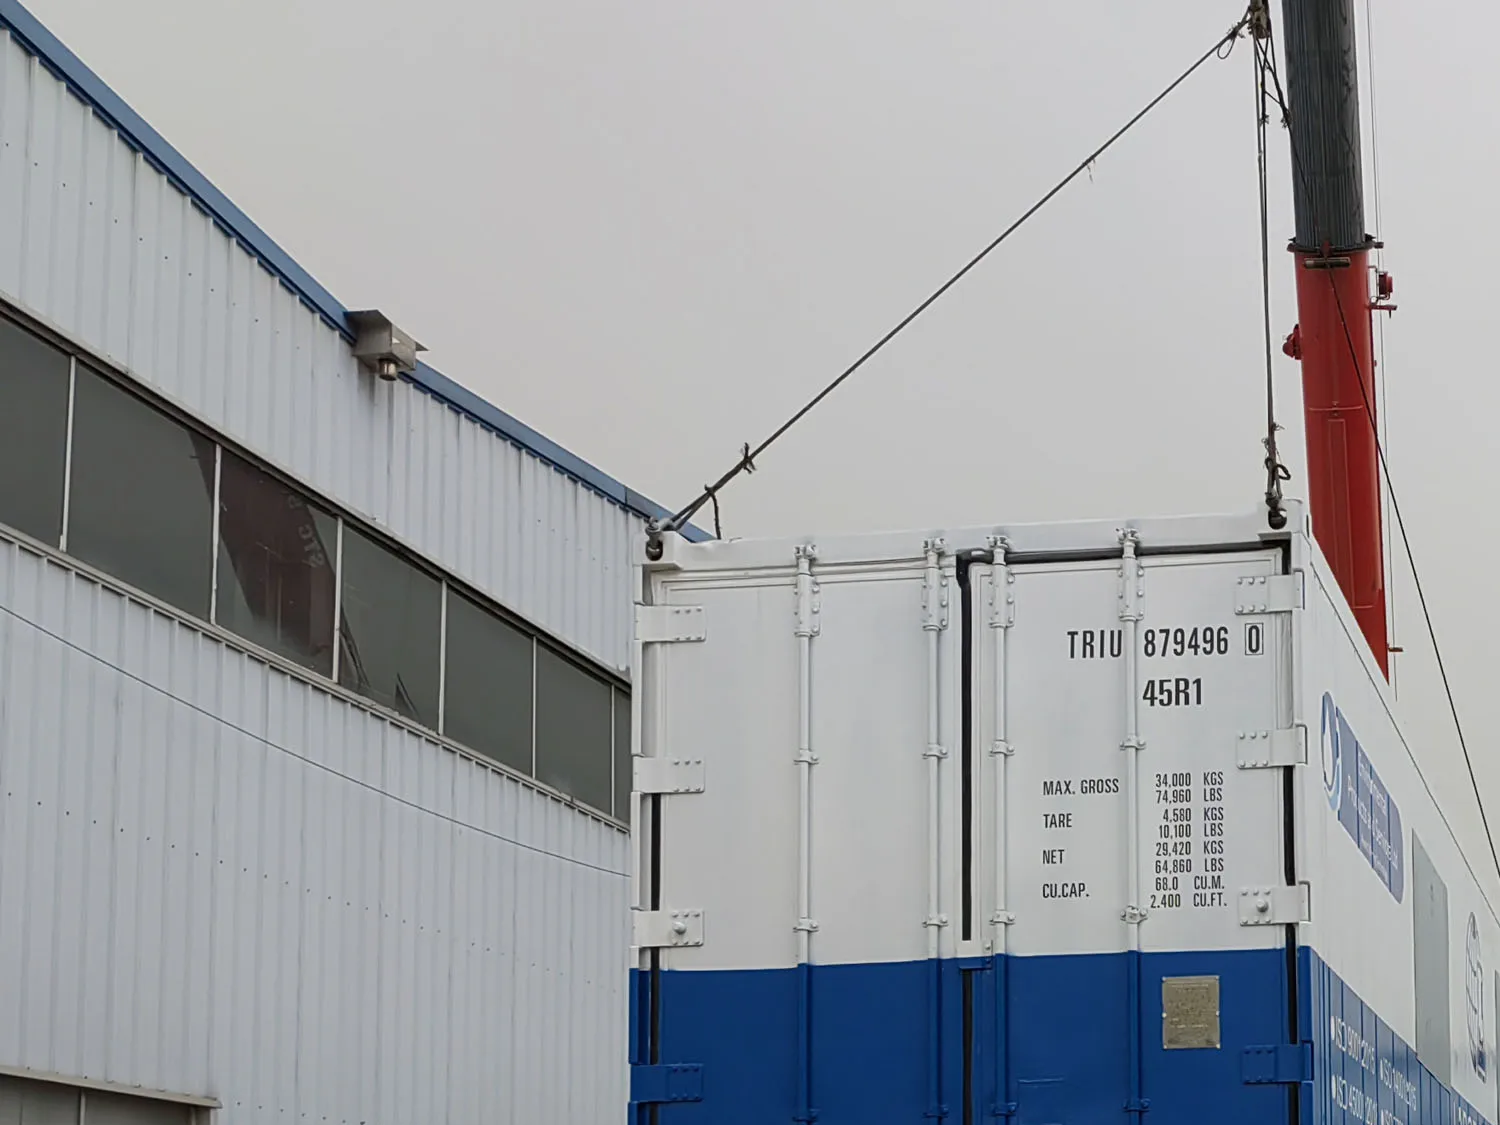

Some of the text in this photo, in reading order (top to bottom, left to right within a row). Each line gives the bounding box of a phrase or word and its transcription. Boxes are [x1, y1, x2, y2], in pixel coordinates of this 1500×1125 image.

[1066, 624, 1261, 659] TRIU 879496 0
[1142, 678, 1202, 707] 45R1
[1042, 771, 1224, 796] MAX. GROSS 34,000 KGS
[1155, 787, 1223, 804] 74,960 LBS
[1043, 812, 1073, 829] TARE
[1203, 806, 1224, 822] KGS
[1203, 822, 1224, 838] LBS
[1042, 840, 1224, 865] NET 29,420 KGS
[1204, 857, 1224, 873] LBS
[1042, 875, 1225, 899] CU.CAP. 68.0 CU.M.
[1150, 892, 1228, 910] 2.400 CU.FT.
